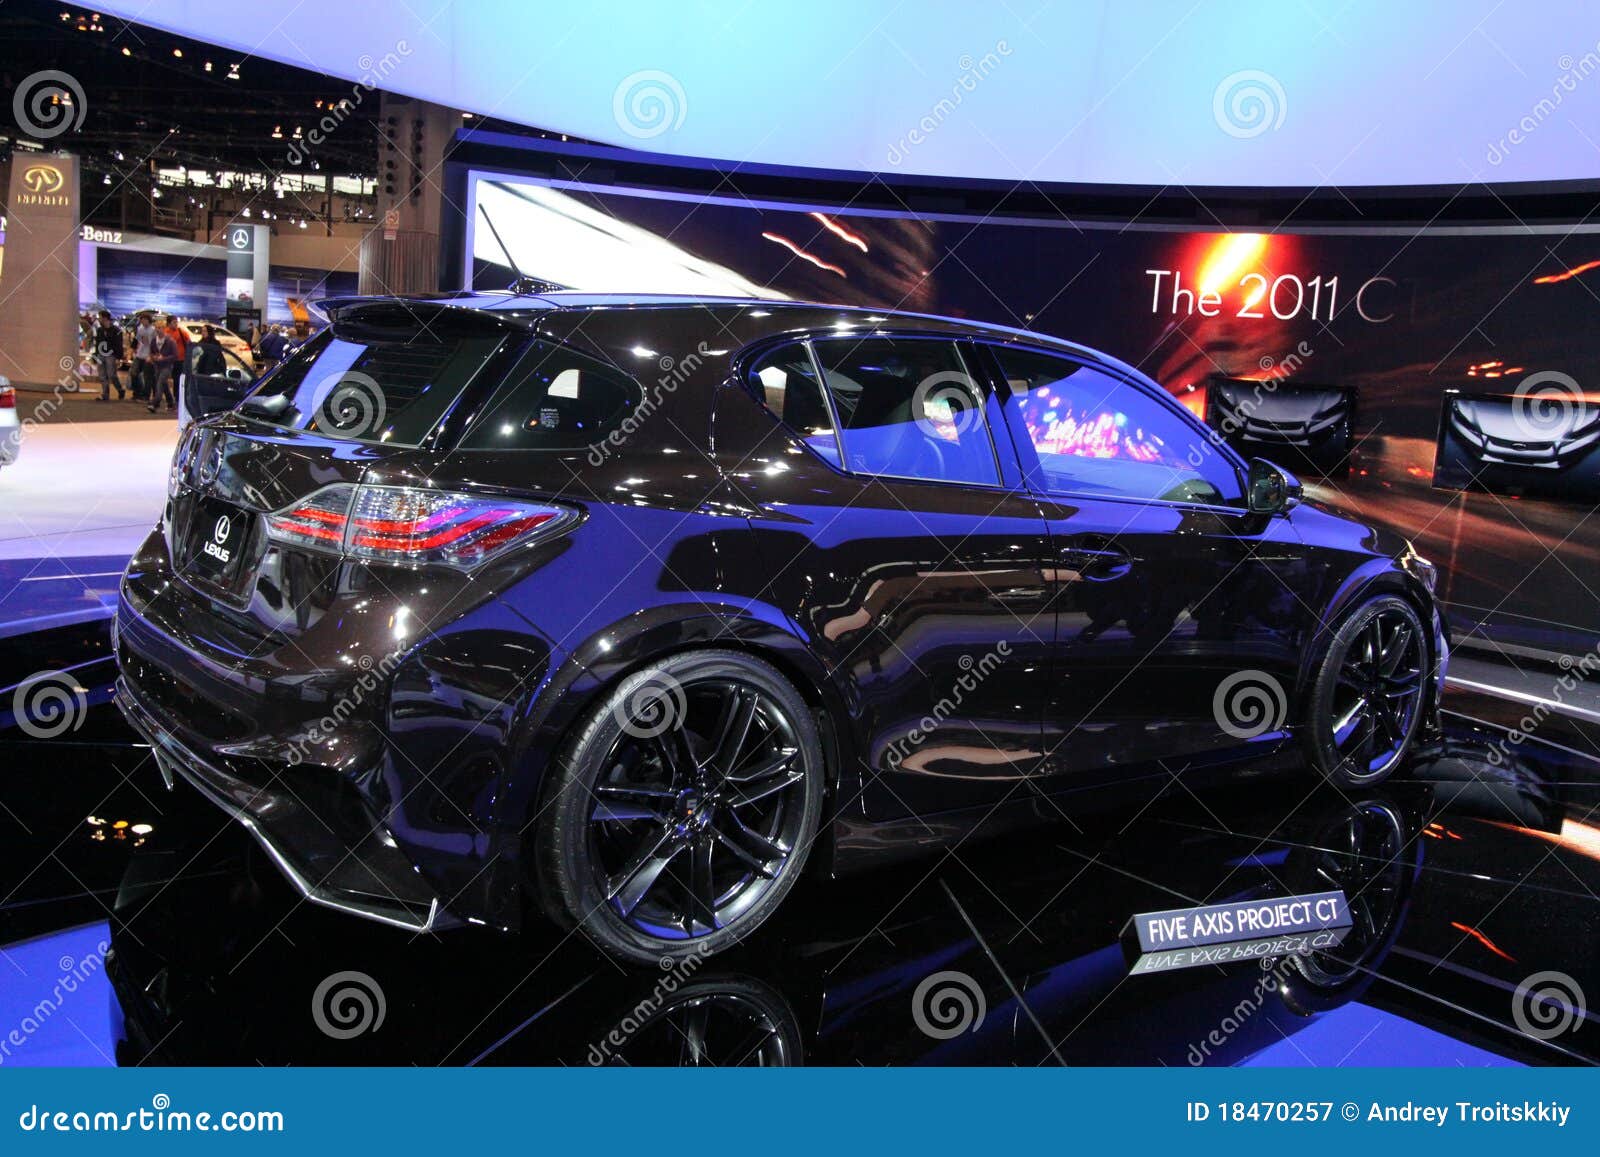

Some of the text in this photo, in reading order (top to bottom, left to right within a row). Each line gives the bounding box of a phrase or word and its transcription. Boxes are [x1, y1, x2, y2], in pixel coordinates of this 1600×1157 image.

[1146, 269, 1222, 316] The
[1236, 273, 1338, 321] 2011
[204, 541, 230, 562] LEXUS
[1148, 899, 1337, 943] FIVE AXIS PROJECT CT
